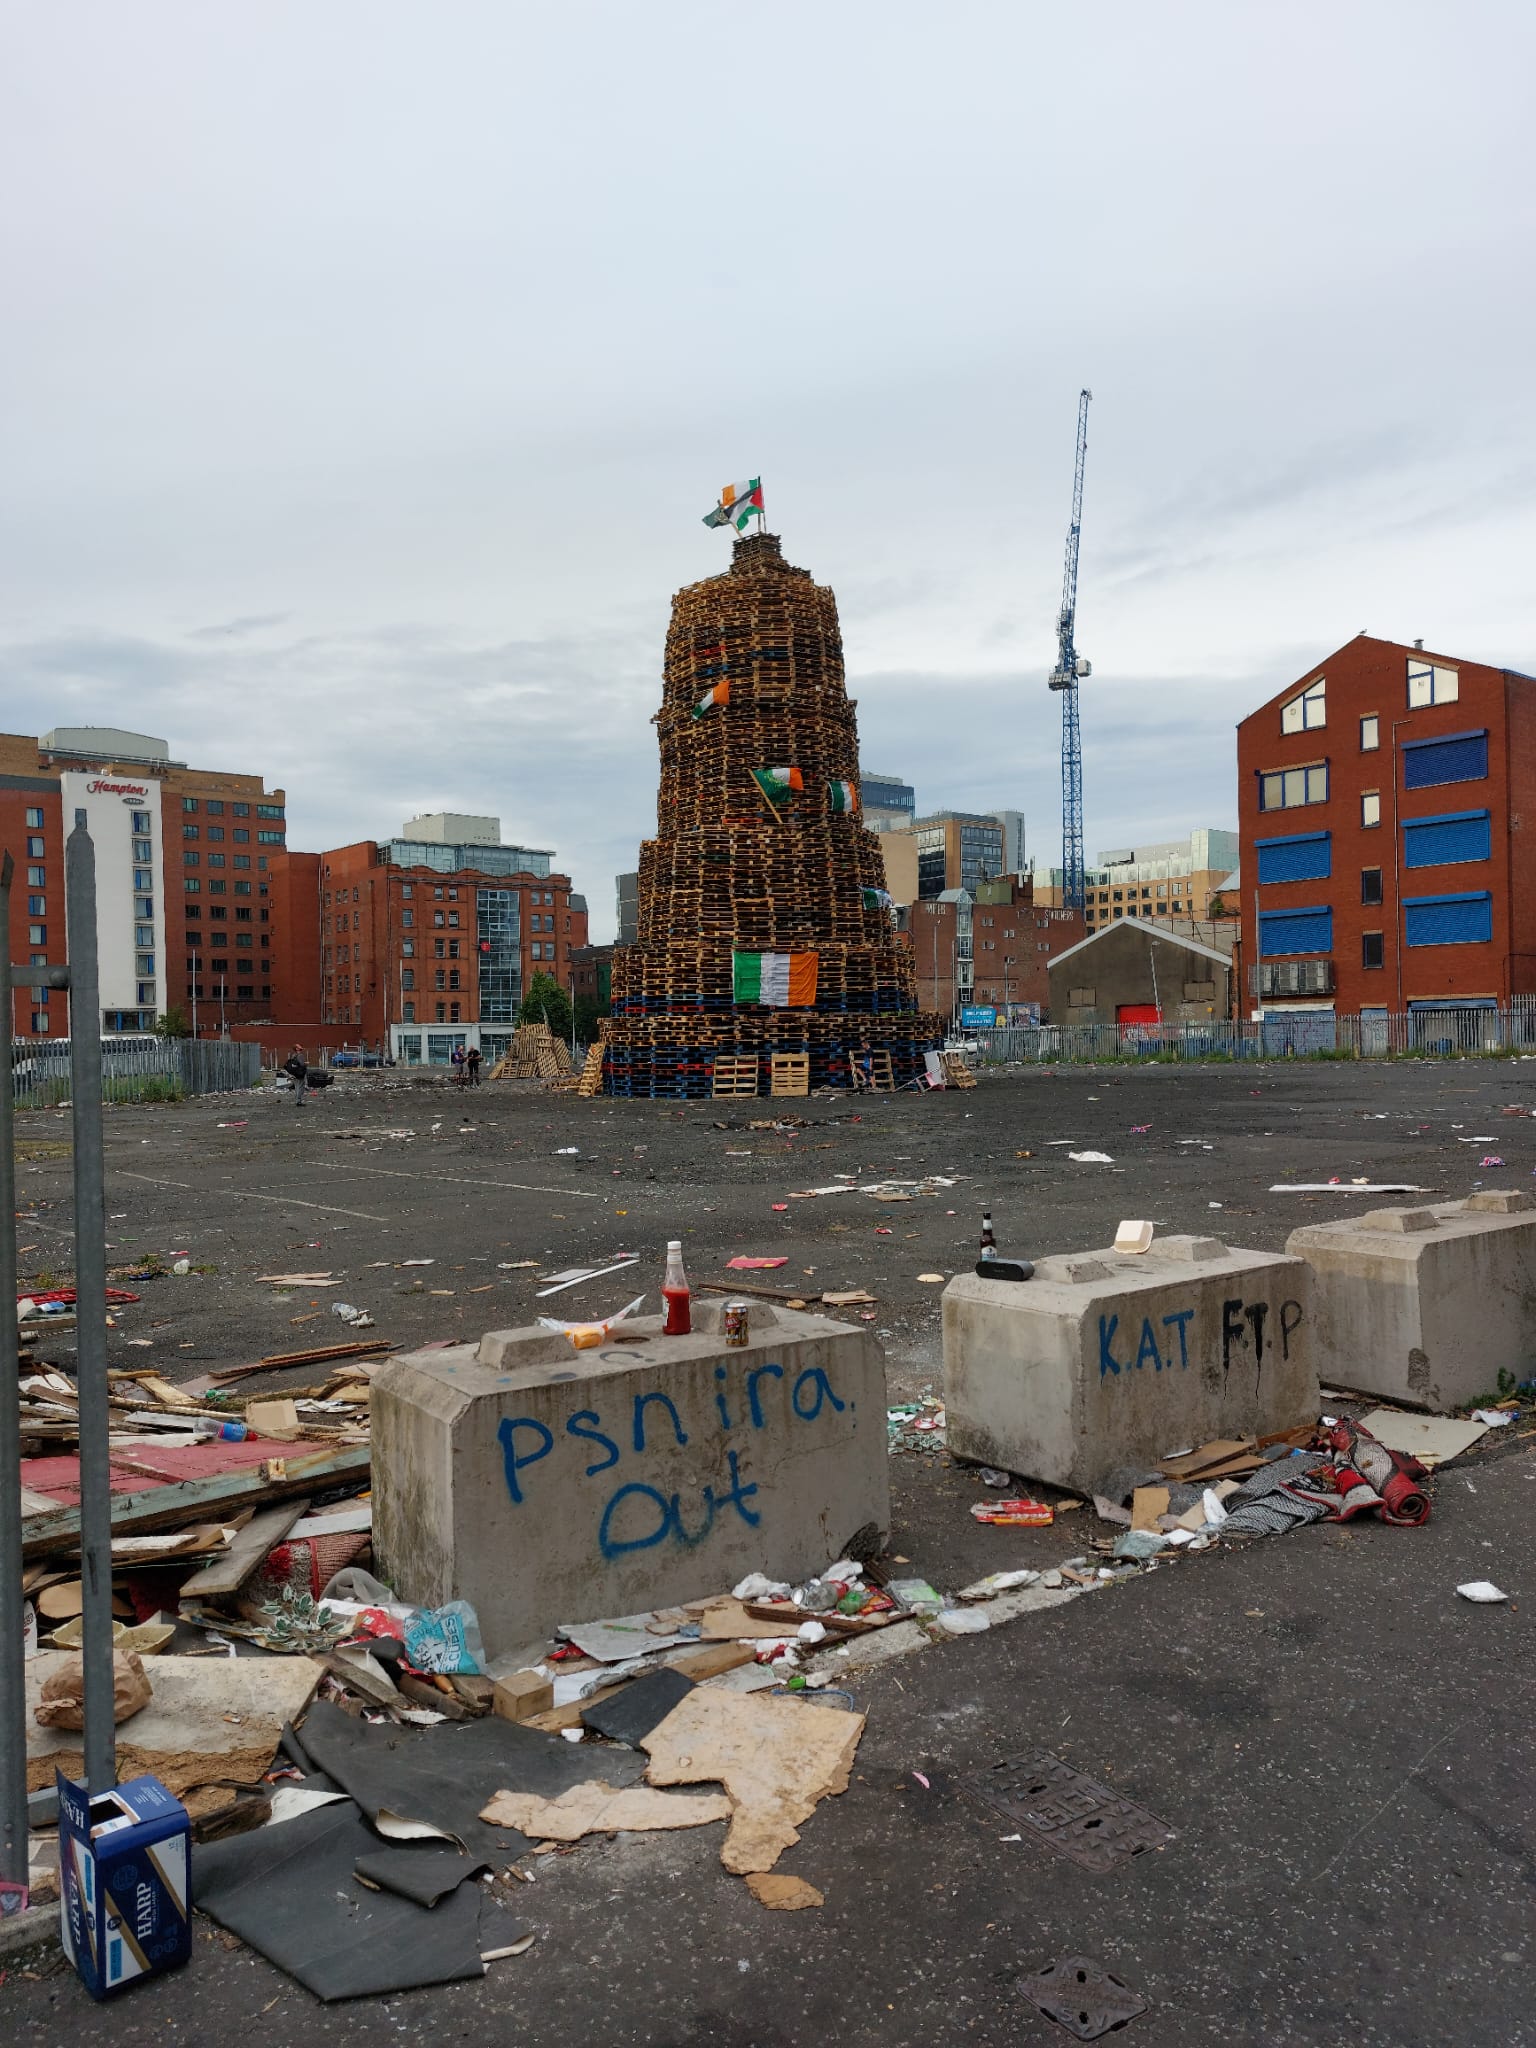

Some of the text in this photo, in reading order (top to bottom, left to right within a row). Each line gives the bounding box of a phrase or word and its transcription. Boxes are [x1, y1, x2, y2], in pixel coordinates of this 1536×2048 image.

[87, 780, 148, 796] Hampton
[445, 1617, 460, 1661] CUBES
[70, 1869, 81, 1945] HARP
[136, 1882, 152, 1940] HARP
